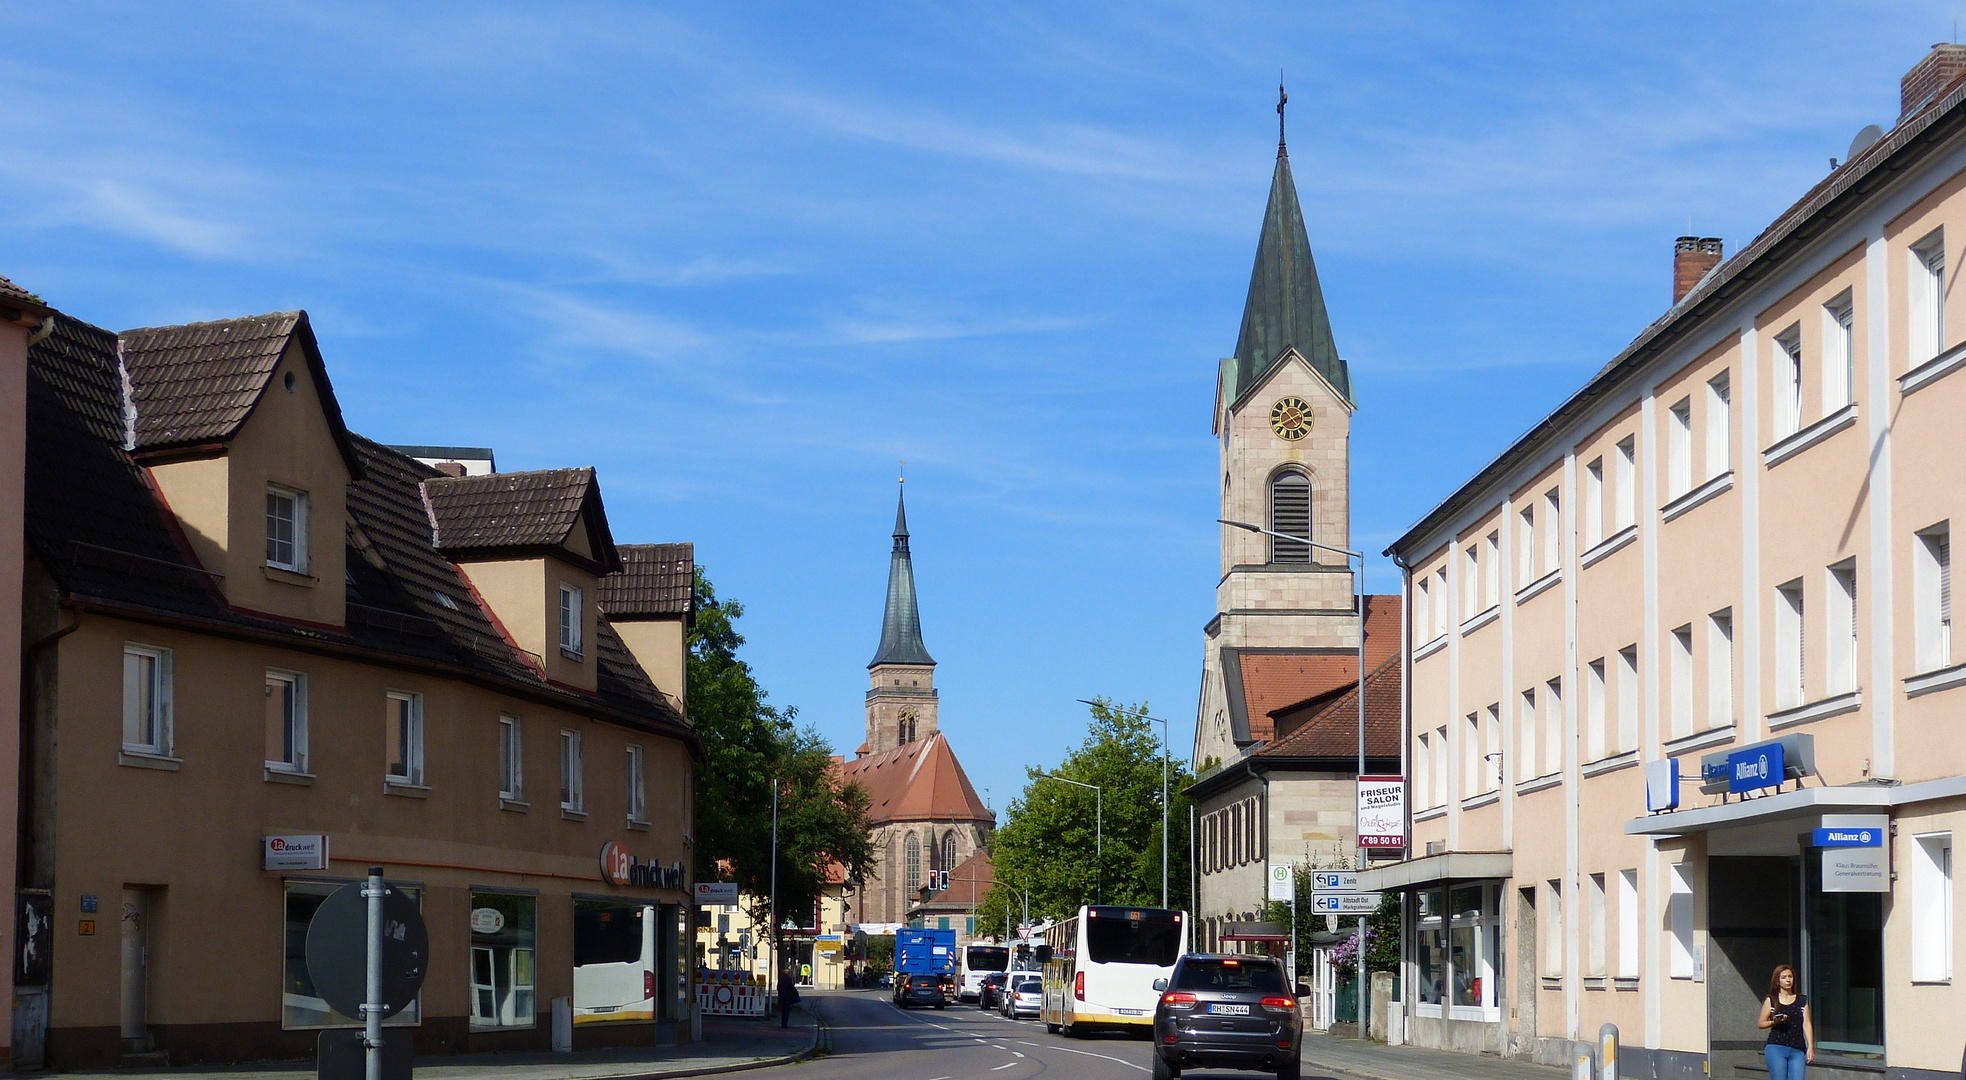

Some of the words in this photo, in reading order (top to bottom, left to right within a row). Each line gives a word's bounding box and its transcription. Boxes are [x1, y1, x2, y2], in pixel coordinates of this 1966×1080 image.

[1736, 762, 1758, 781] Allianz
[1360, 786, 1402, 798] FRISEUR
[1367, 795, 1399, 805] SALON
[1368, 836, 1378, 845] 89
[1380, 836, 1390, 845] 50
[1391, 836, 1401, 845] 61
[1827, 832, 1859, 841] Allianz
[1835, 870, 1882, 878] Generalvertretung
